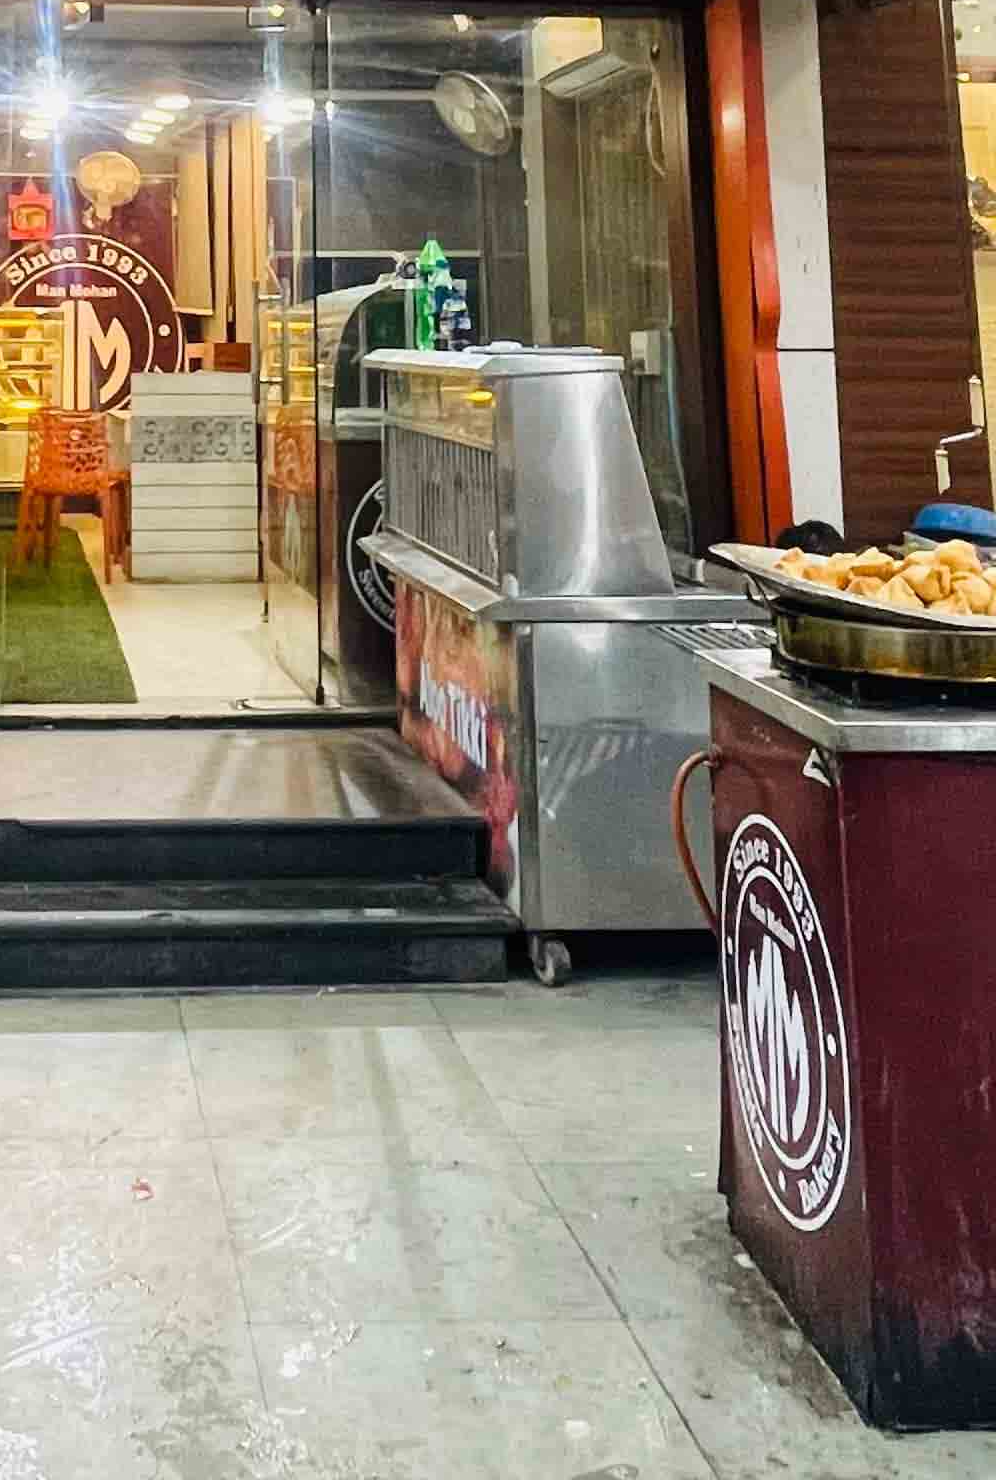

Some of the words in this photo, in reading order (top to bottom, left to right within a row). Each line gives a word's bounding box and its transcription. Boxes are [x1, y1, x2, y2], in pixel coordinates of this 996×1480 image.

[6, 246, 77, 286] Since
[87, 243, 150, 286] 1993
[733, 838, 769, 883] Since
[746, 934, 810, 1144] MM
[797, 1110, 843, 1215] Bakery
